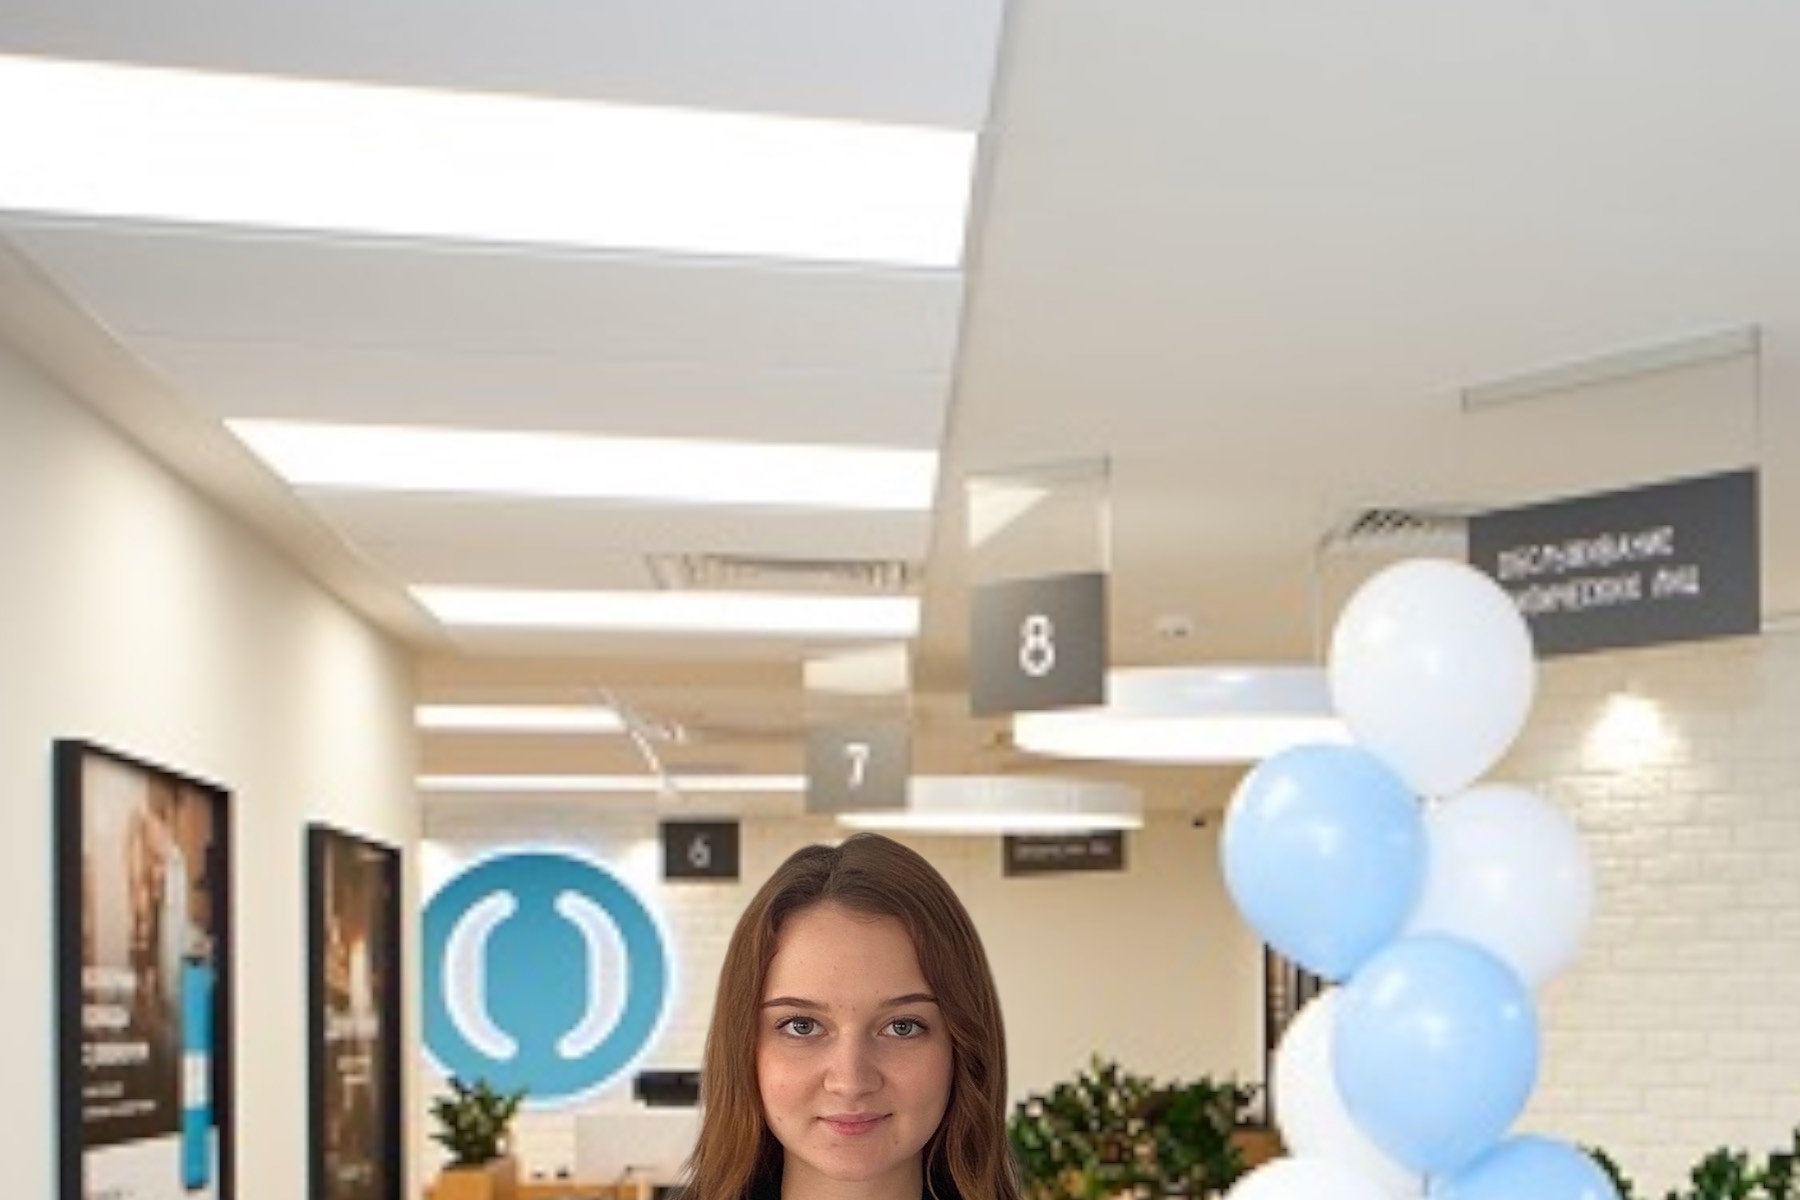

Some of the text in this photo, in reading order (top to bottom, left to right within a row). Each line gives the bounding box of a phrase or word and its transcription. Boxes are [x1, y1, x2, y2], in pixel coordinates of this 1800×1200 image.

[1018, 614, 1056, 678] 8
[841, 741, 871, 788] 7
[687, 833, 712, 869] 6
